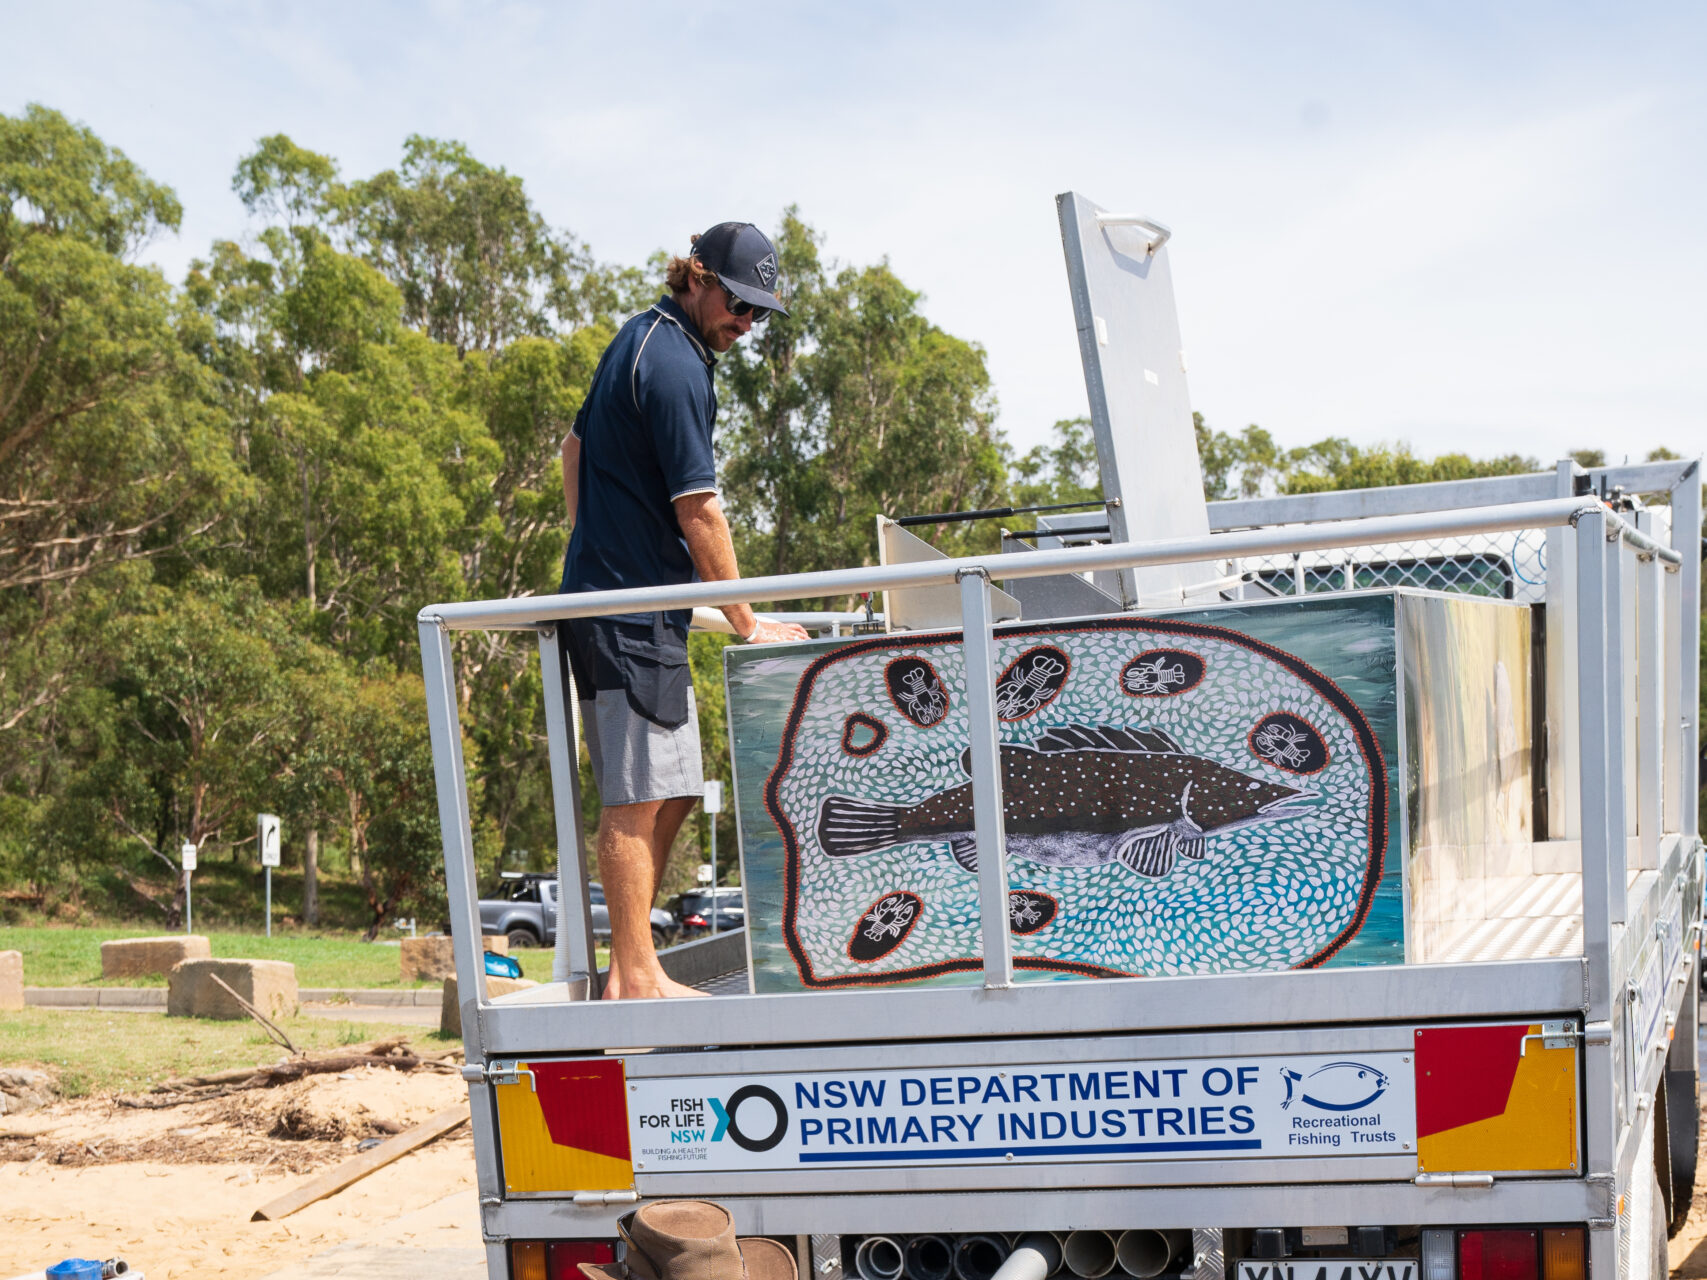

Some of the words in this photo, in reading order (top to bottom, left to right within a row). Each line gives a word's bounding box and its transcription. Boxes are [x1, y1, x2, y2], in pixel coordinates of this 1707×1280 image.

[795, 1080, 886, 1109] NSW
[900, 1069, 1188, 1106] DEPARTMENT
[1202, 1066, 1259, 1096] OF
[671, 1098, 704, 1112] FISH
[640, 1115, 670, 1128] FOR
[675, 1114, 705, 1127] LIFE
[800, 1114, 983, 1145] PRIMARY
[998, 1105, 1256, 1141] INDUSTRIES
[1292, 1114, 1381, 1129] Recreational
[671, 1129, 706, 1143] NSW
[1289, 1132, 1341, 1147] Fishing
[1350, 1131, 1396, 1143] Trusts
